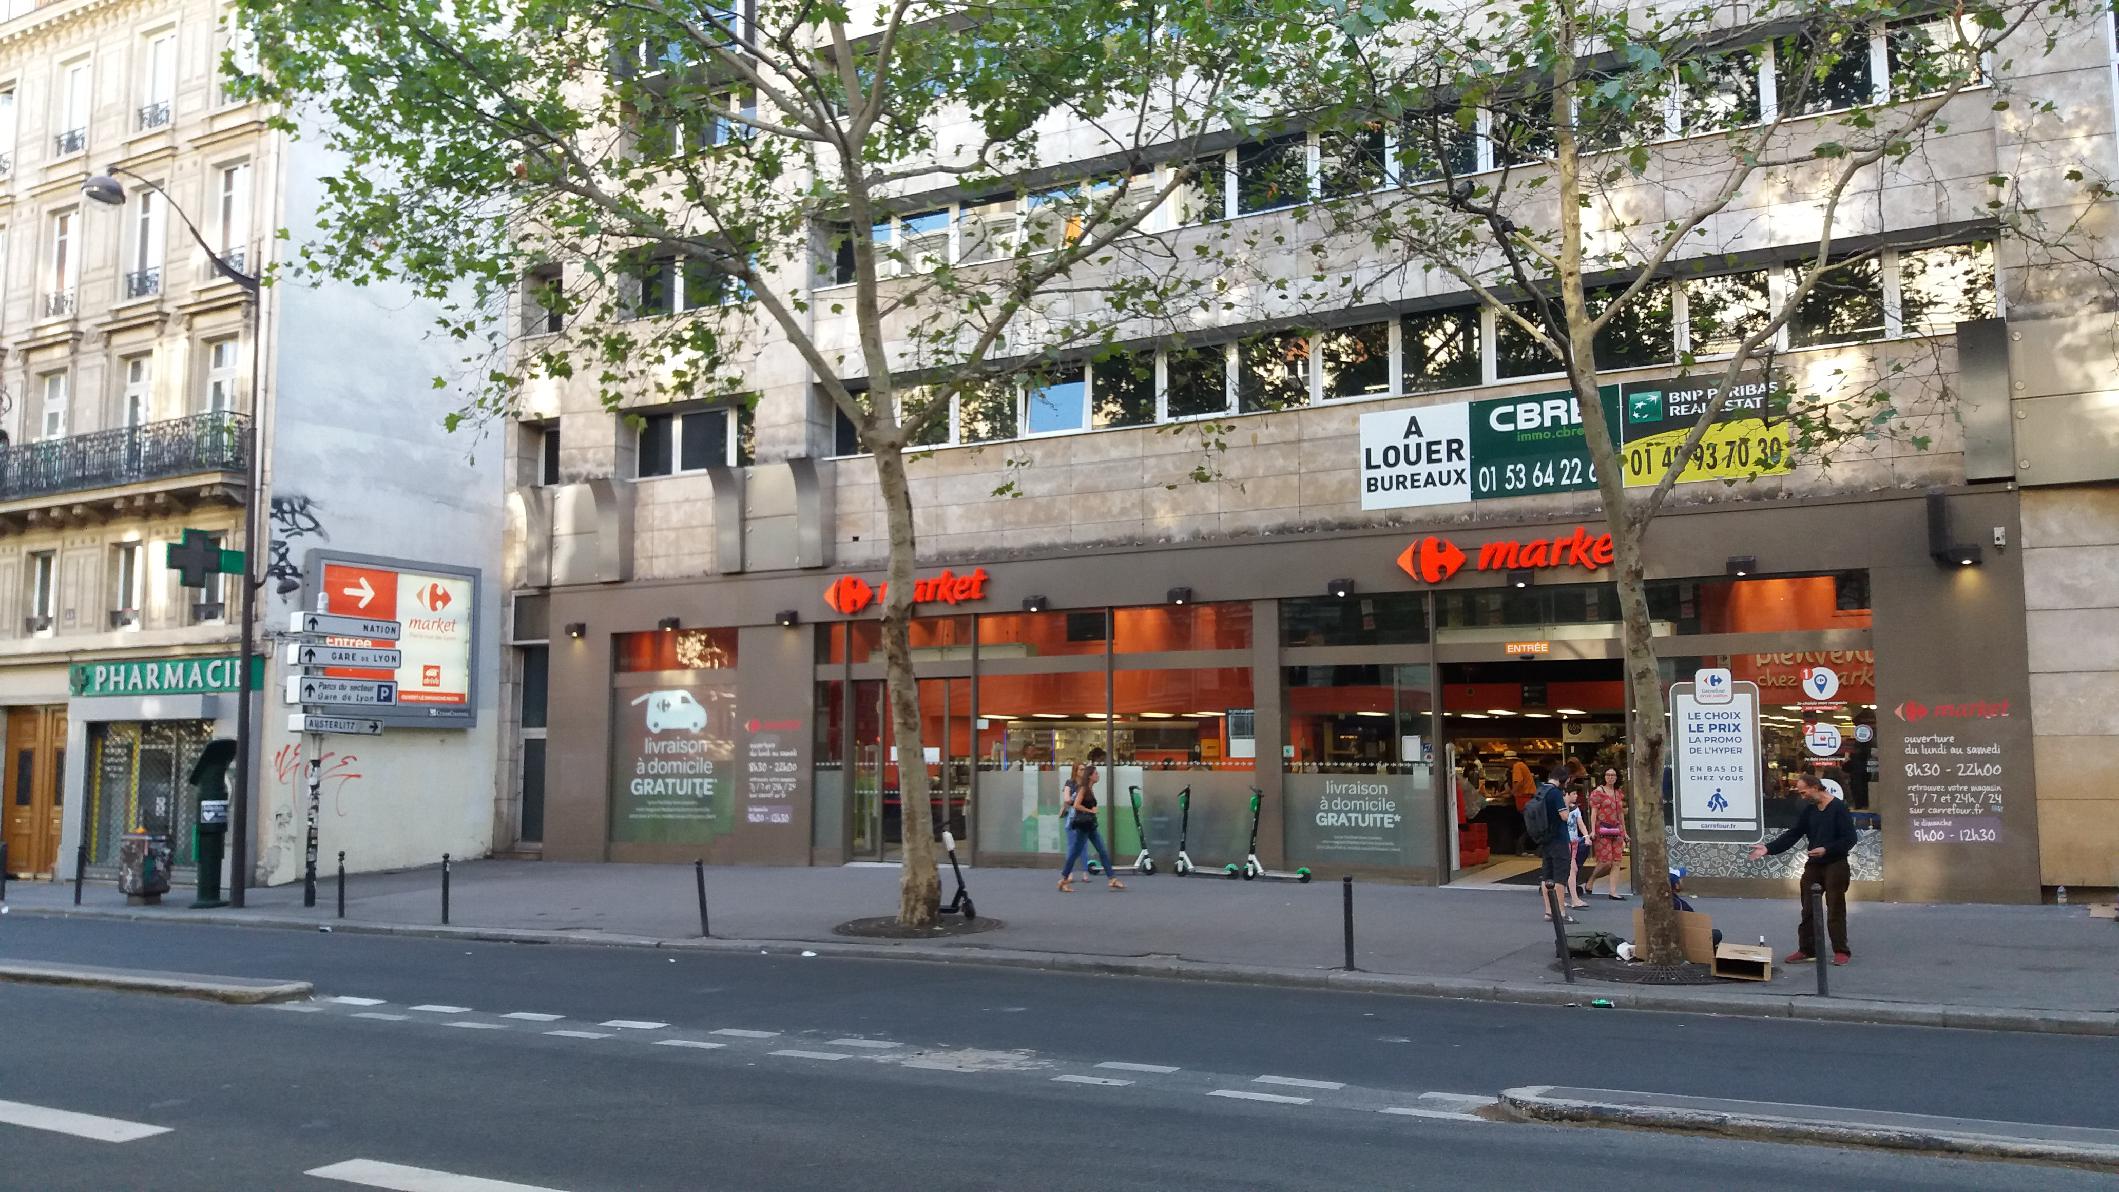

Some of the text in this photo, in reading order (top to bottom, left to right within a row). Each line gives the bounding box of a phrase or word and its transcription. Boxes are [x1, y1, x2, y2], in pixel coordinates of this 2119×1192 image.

[1669, 381, 1779, 404] BNP PRIBAS
[1403, 415, 1423, 440] A
[1517, 426, 1585, 442] immo.cbre
[1365, 438, 1466, 470] LOUER
[1630, 448, 1652, 476] 01
[1693, 443, 1718, 471] 93
[1725, 439, 1750, 469] 70
[1366, 468, 1467, 493] BUREAUX
[1479, 466, 1497, 492] 01
[1505, 463, 1526, 490] 53
[1532, 459, 1554, 487] 64
[1560, 457, 1583, 485] 22
[1478, 525, 1614, 571] marke
[363, 623, 396, 635] NATION
[408, 616, 457, 633] market
[1506, 642, 1549, 654] ENTRÉE
[331, 651, 357, 661] GARE
[373, 654, 397, 663] LYON
[1757, 668, 1797, 687] chez
[1687, 711, 1741, 720] LE CHOIX
[309, 719, 356, 730] AUSTERLITZ
[1688, 723, 1741, 733] LE PRIX
[644, 736, 708, 754] livraison
[1688, 736, 1743, 744] LA PROMO
[1904, 734, 1955, 744] ouverture
[1689, 746, 1743, 755] DE L'HYPER
[1904, 742, 2001, 755] du lundi au samedi
[636, 757, 714, 775] à domicile
[1689, 765, 1744, 773] EN BAS DE
[1904, 763, 1940, 777] 8h30
[1956, 762, 2002, 777] 22h00
[1325, 780, 1388, 795] livraison
[1907, 783, 2002, 794] retrouvez votre magasin
[1319, 796, 1396, 812] à domicile
[1940, 793, 1952, 803] et
[1954, 793, 1977, 803] 24h
[1988, 793, 2002, 804] 24
[1927, 803, 1984, 814] carrefour.fr
[1914, 828, 1945, 842] 9h00
[1959, 828, 1996, 841] 12h30
